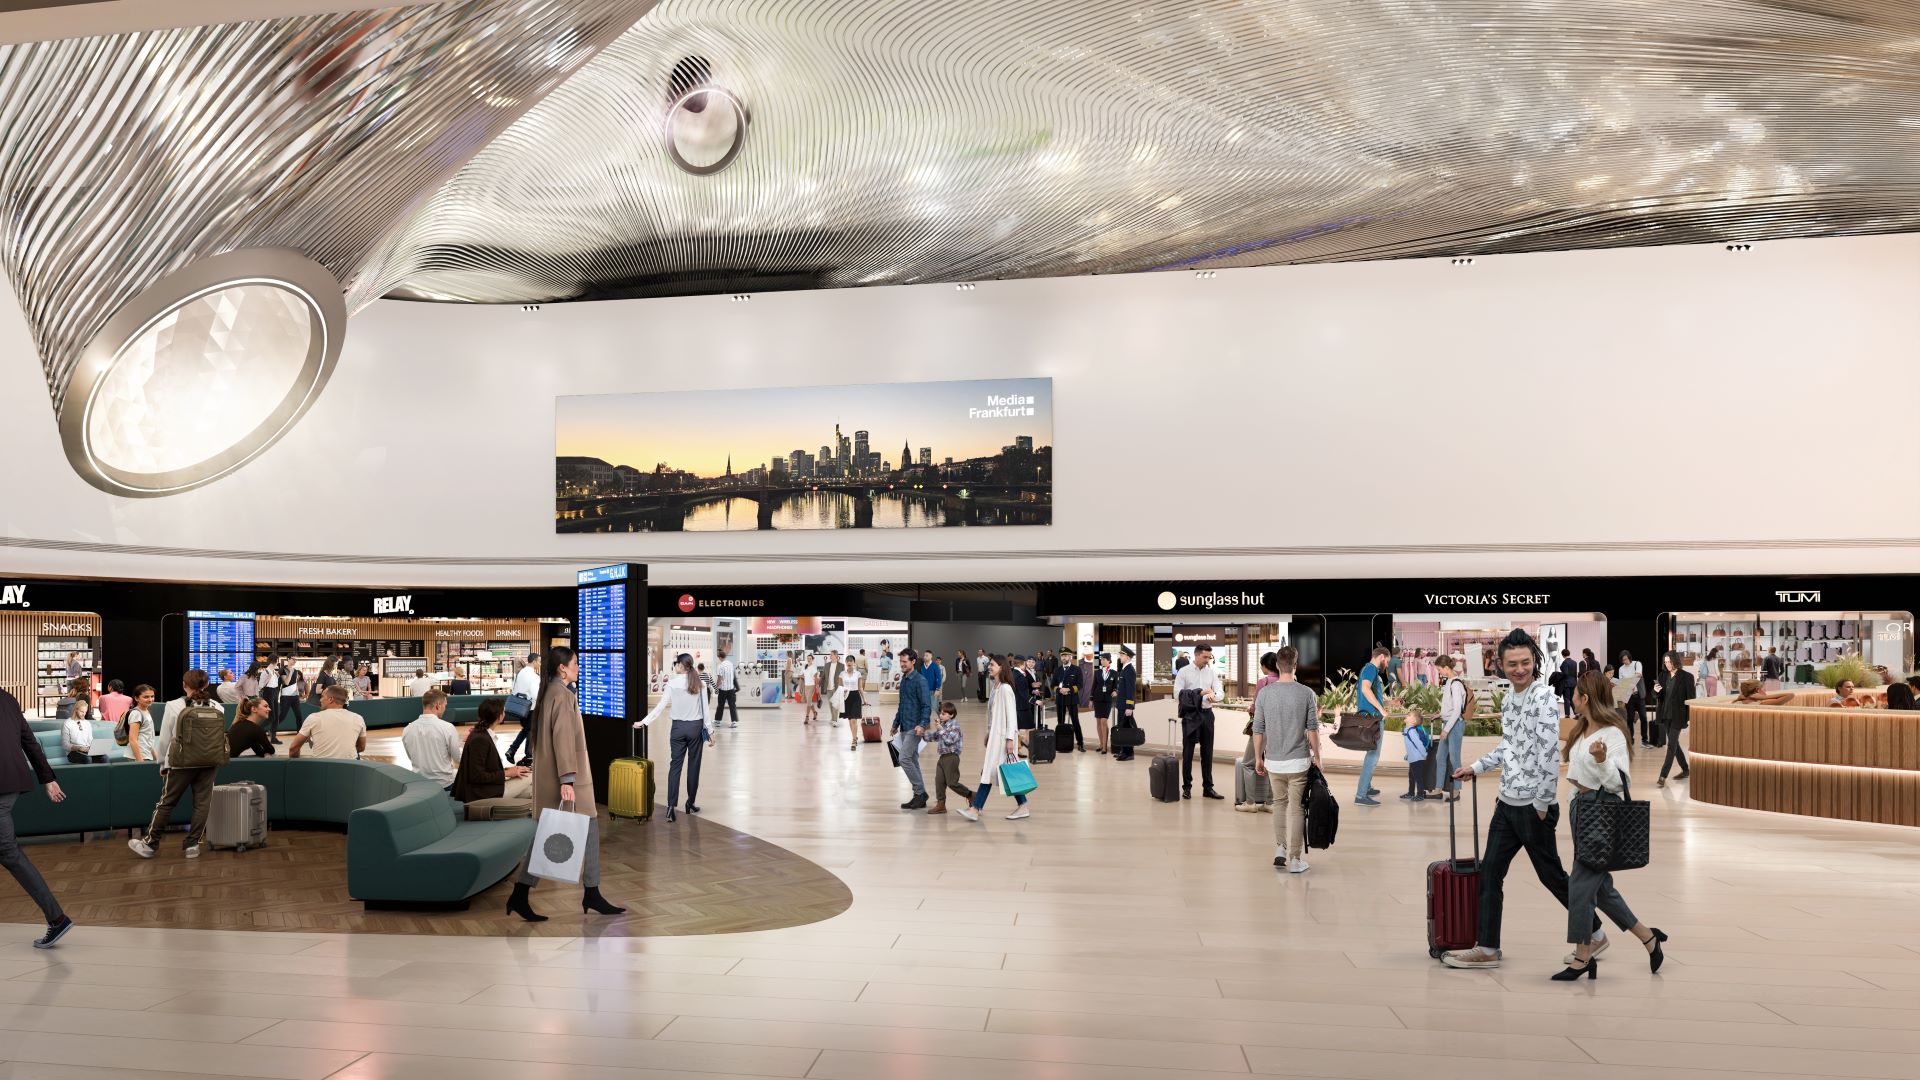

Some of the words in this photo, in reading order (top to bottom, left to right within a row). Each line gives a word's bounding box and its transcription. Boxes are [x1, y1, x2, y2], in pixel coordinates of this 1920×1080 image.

[987, 395, 1026, 406] Media
[969, 406, 1026, 419] Frankfurt
[1180, 592, 1239, 609] sunglass
[1241, 592, 1265, 606] hut
[1424, 593, 1498, 605] VICTORIA'S
[1502, 593, 1551, 605] SECRET
[1775, 591, 1821, 603] TUMI
[373, 595, 412, 614] RELAY
[698, 599, 765, 607] ELECTRONICS
[43, 623, 92, 632] SNACKS
[298, 627, 324, 635] FRESH
[1183, 634, 1206, 642] sunglass
